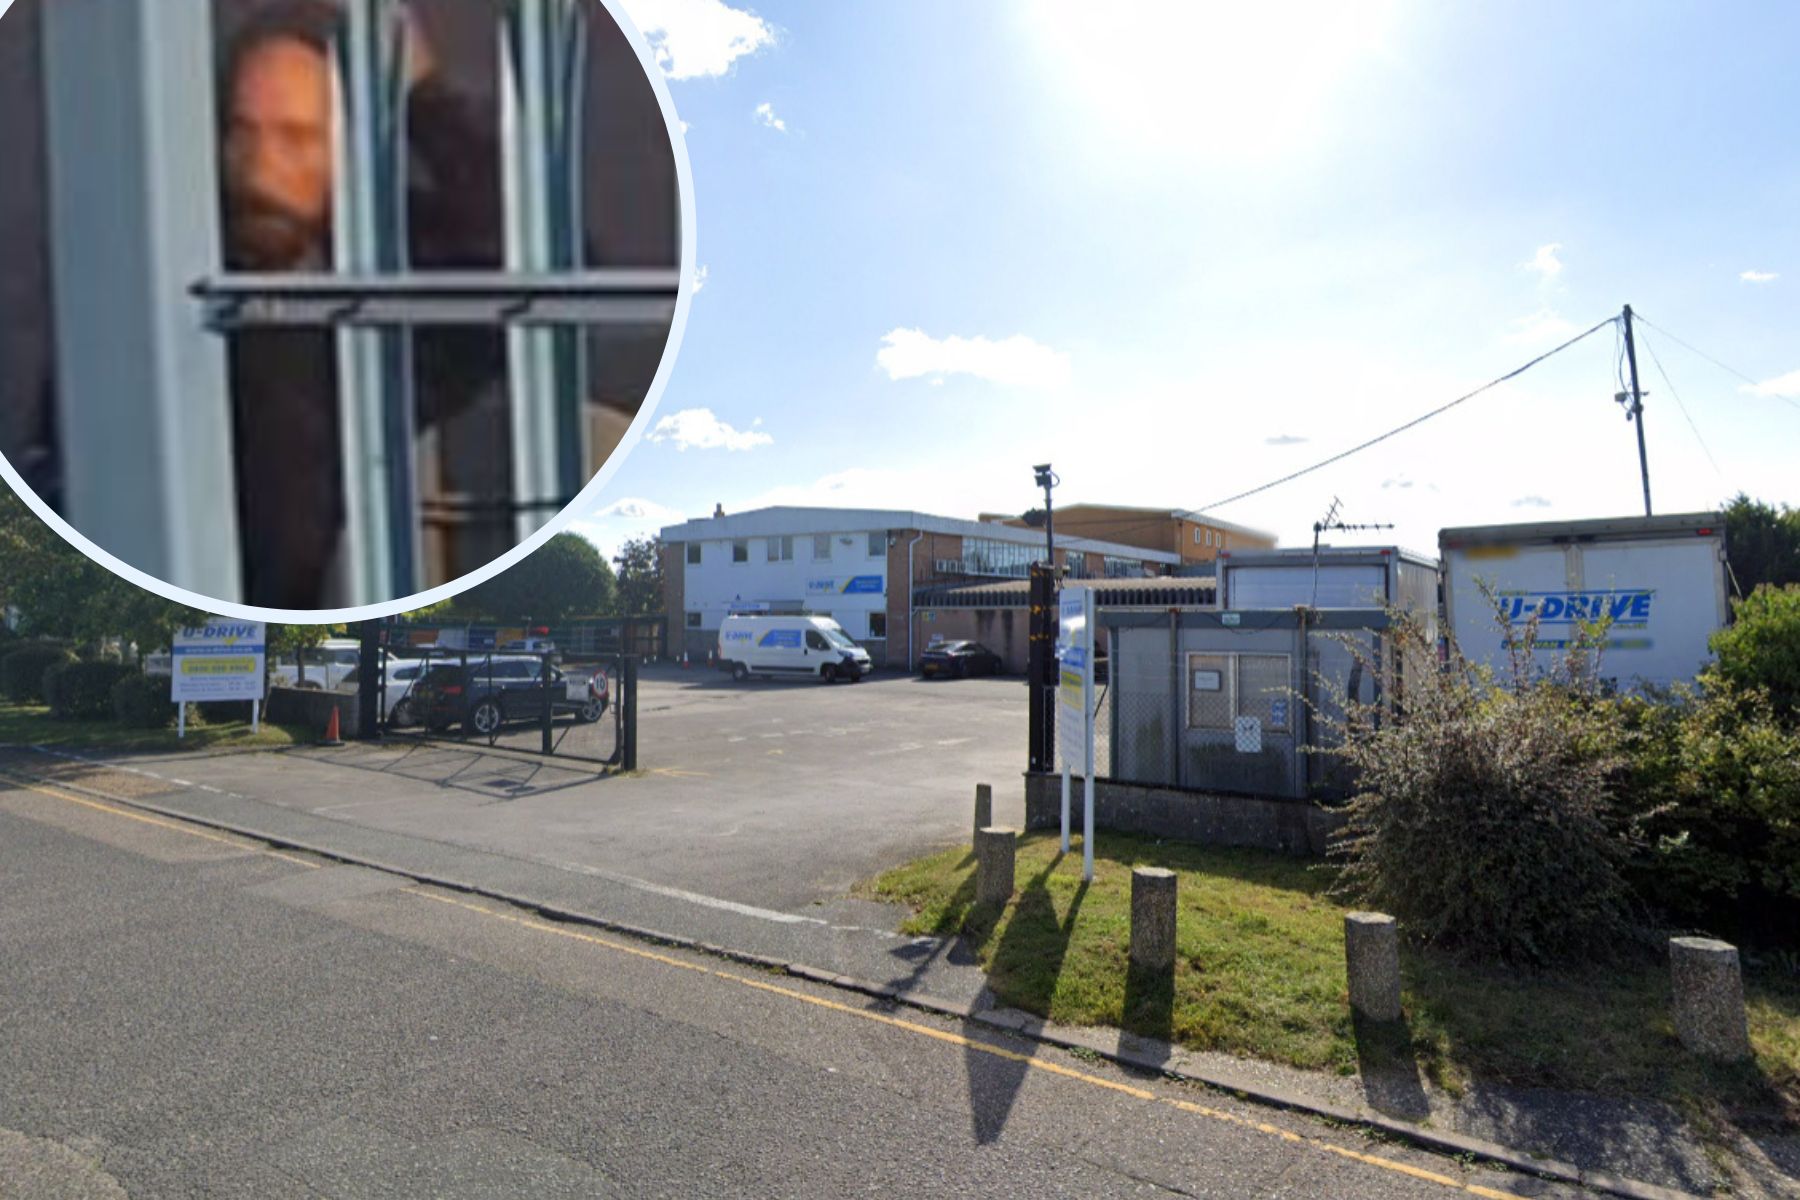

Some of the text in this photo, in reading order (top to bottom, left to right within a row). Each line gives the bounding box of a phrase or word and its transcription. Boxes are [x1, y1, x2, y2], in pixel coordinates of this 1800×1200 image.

[1500, 595, 1651, 619] U-DRIVE
[183, 623, 257, 639] U-DRIVE
[596, 677, 605, 689] 10
